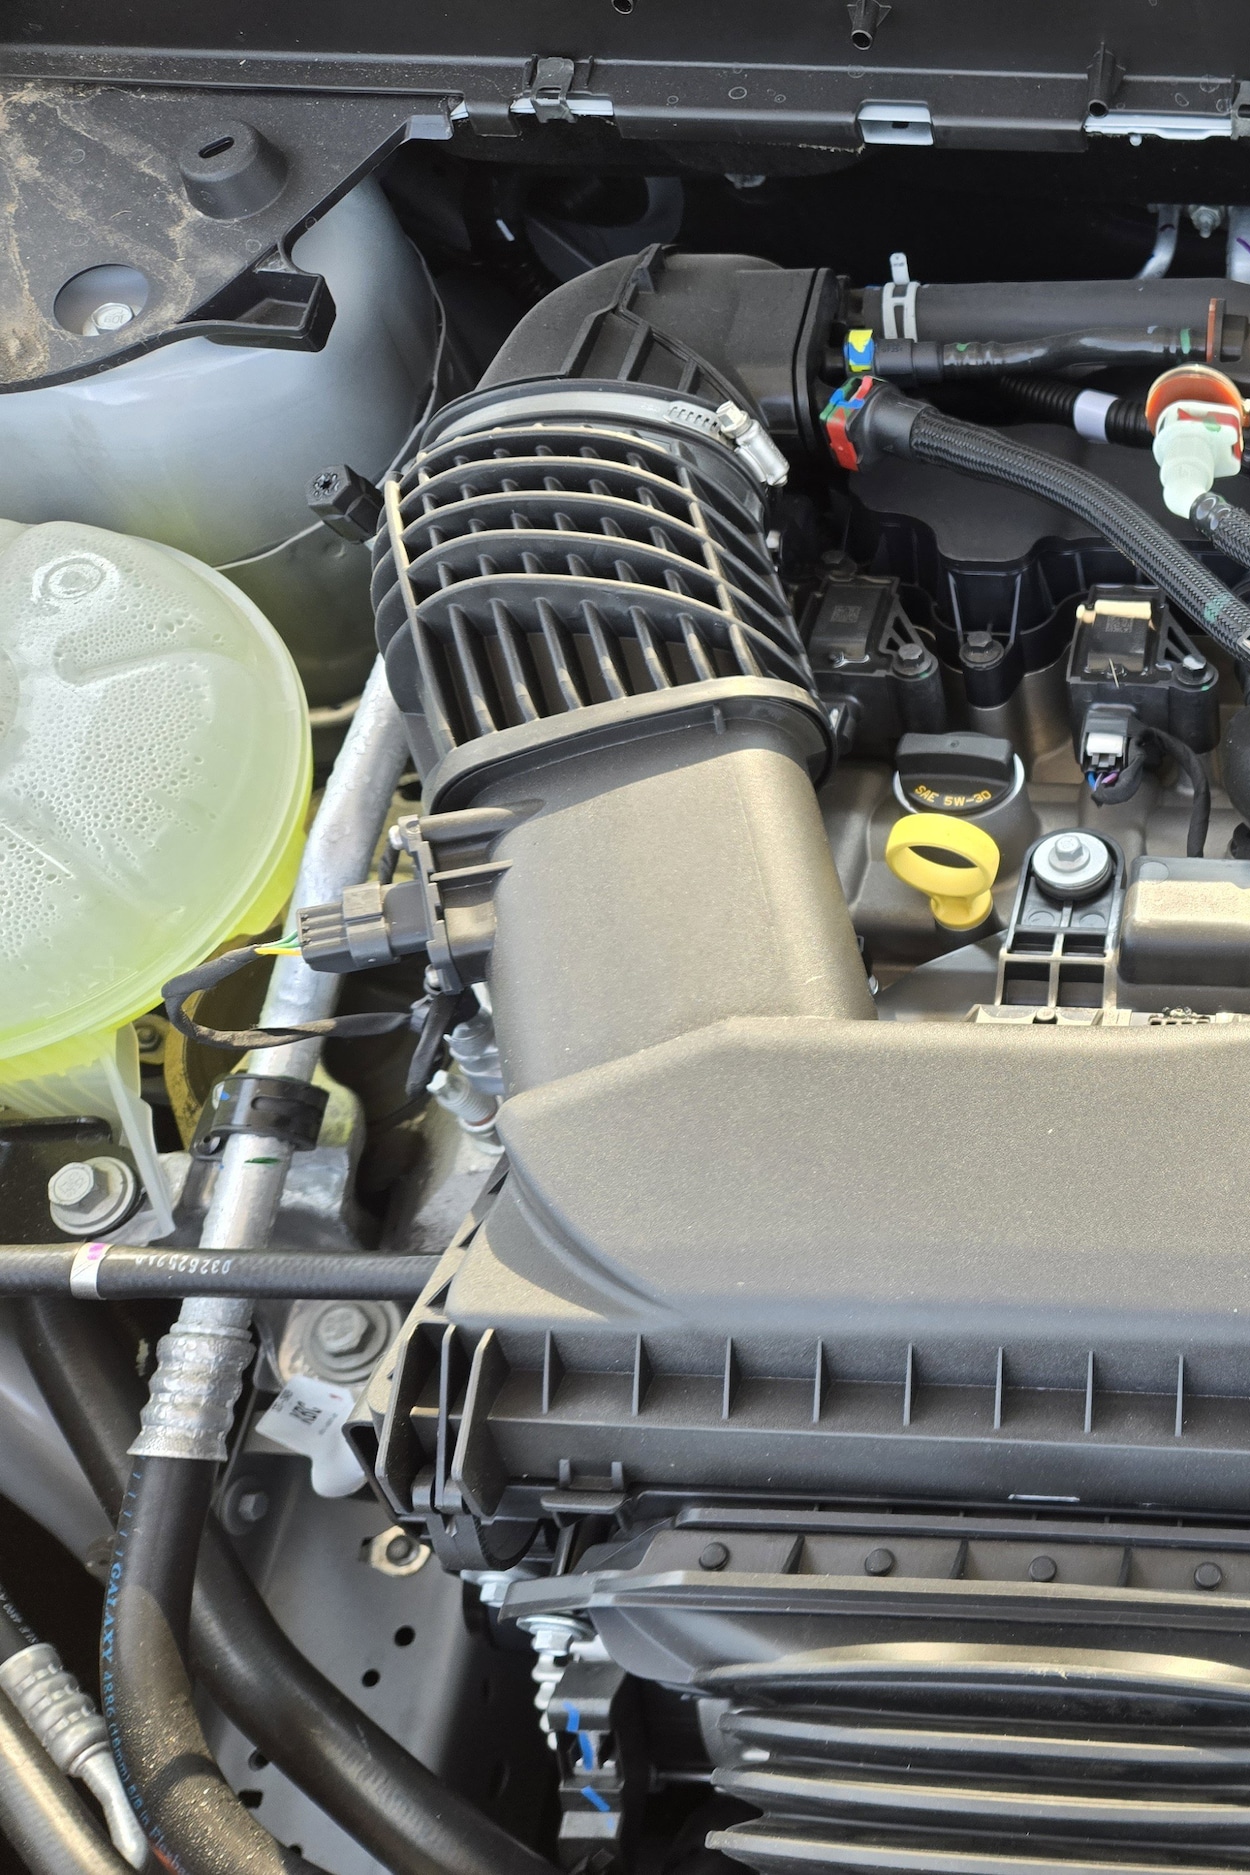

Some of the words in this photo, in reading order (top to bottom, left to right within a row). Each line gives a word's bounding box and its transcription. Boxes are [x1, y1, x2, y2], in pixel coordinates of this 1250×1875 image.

[914, 785, 940, 803] SAE
[943, 790, 992, 807] 5W-30
[101, 1562, 122, 1663] GALAXY
